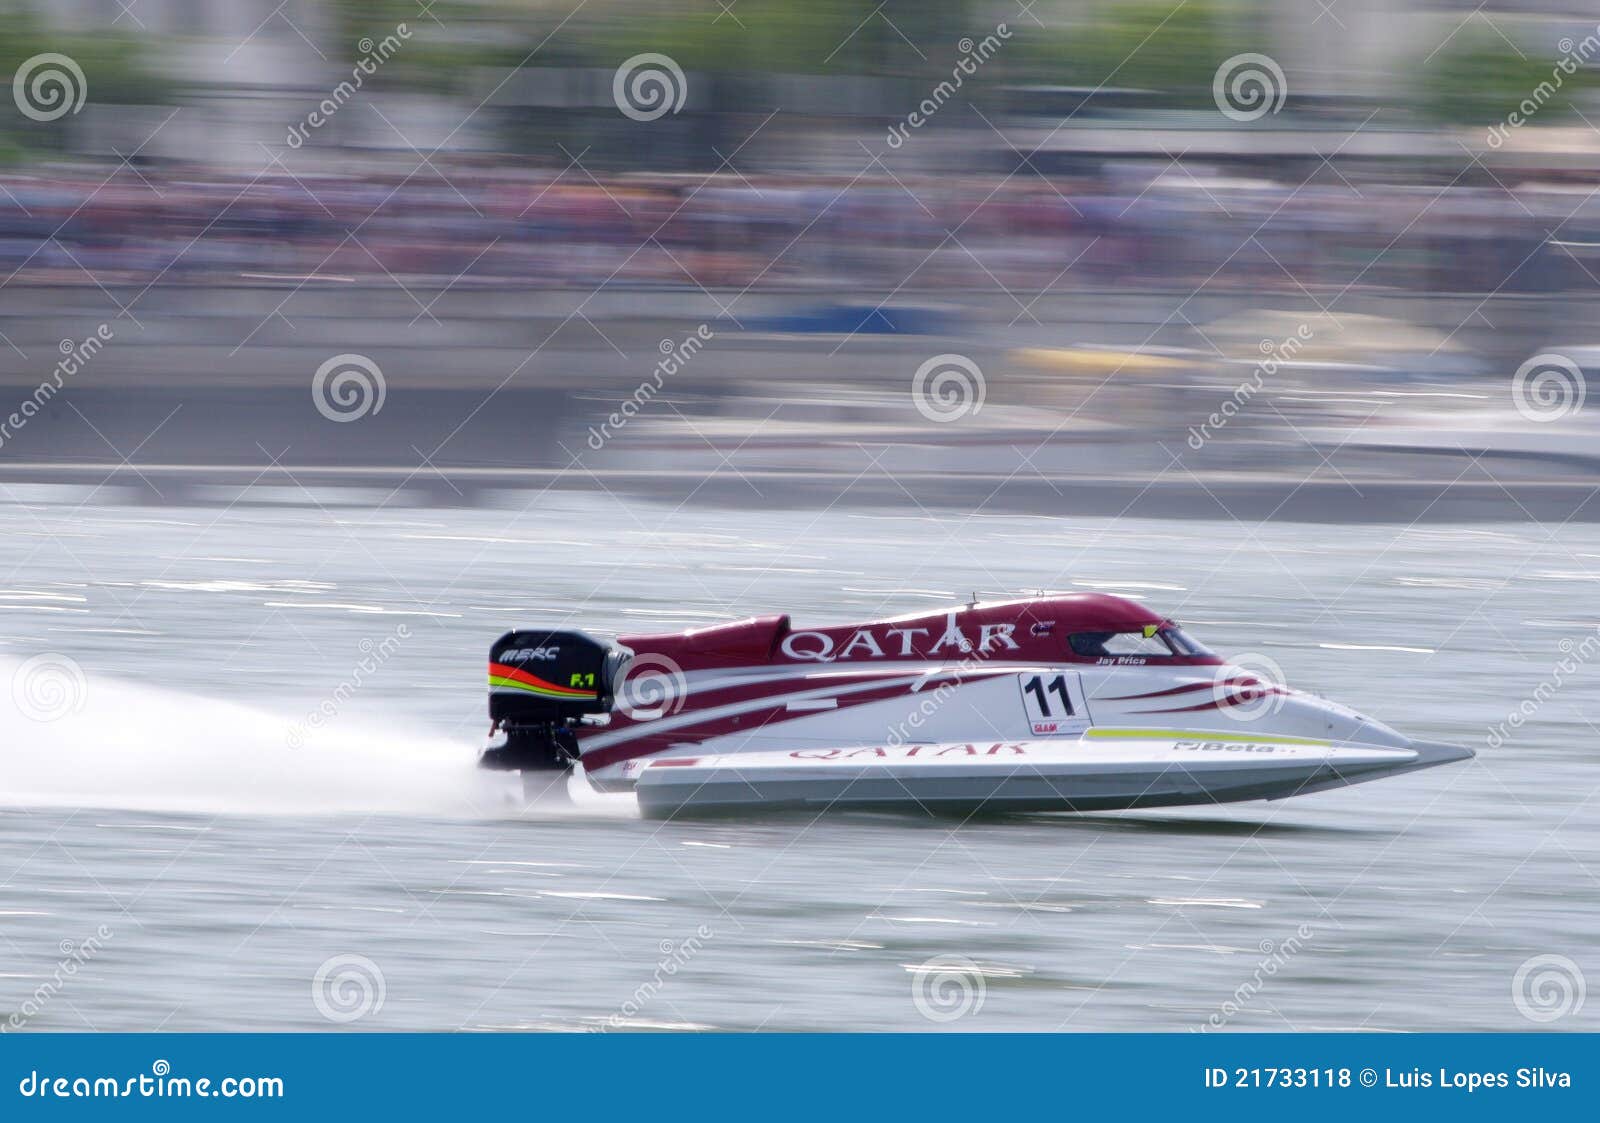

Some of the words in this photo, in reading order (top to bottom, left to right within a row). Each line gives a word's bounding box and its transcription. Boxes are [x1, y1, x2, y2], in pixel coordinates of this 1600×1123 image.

[499, 646, 560, 662] MERC
[780, 622, 1021, 662] QATAR
[1096, 656, 1115, 667] Jay
[1117, 656, 1147, 666] Price
[1024, 674, 1076, 717] 11
